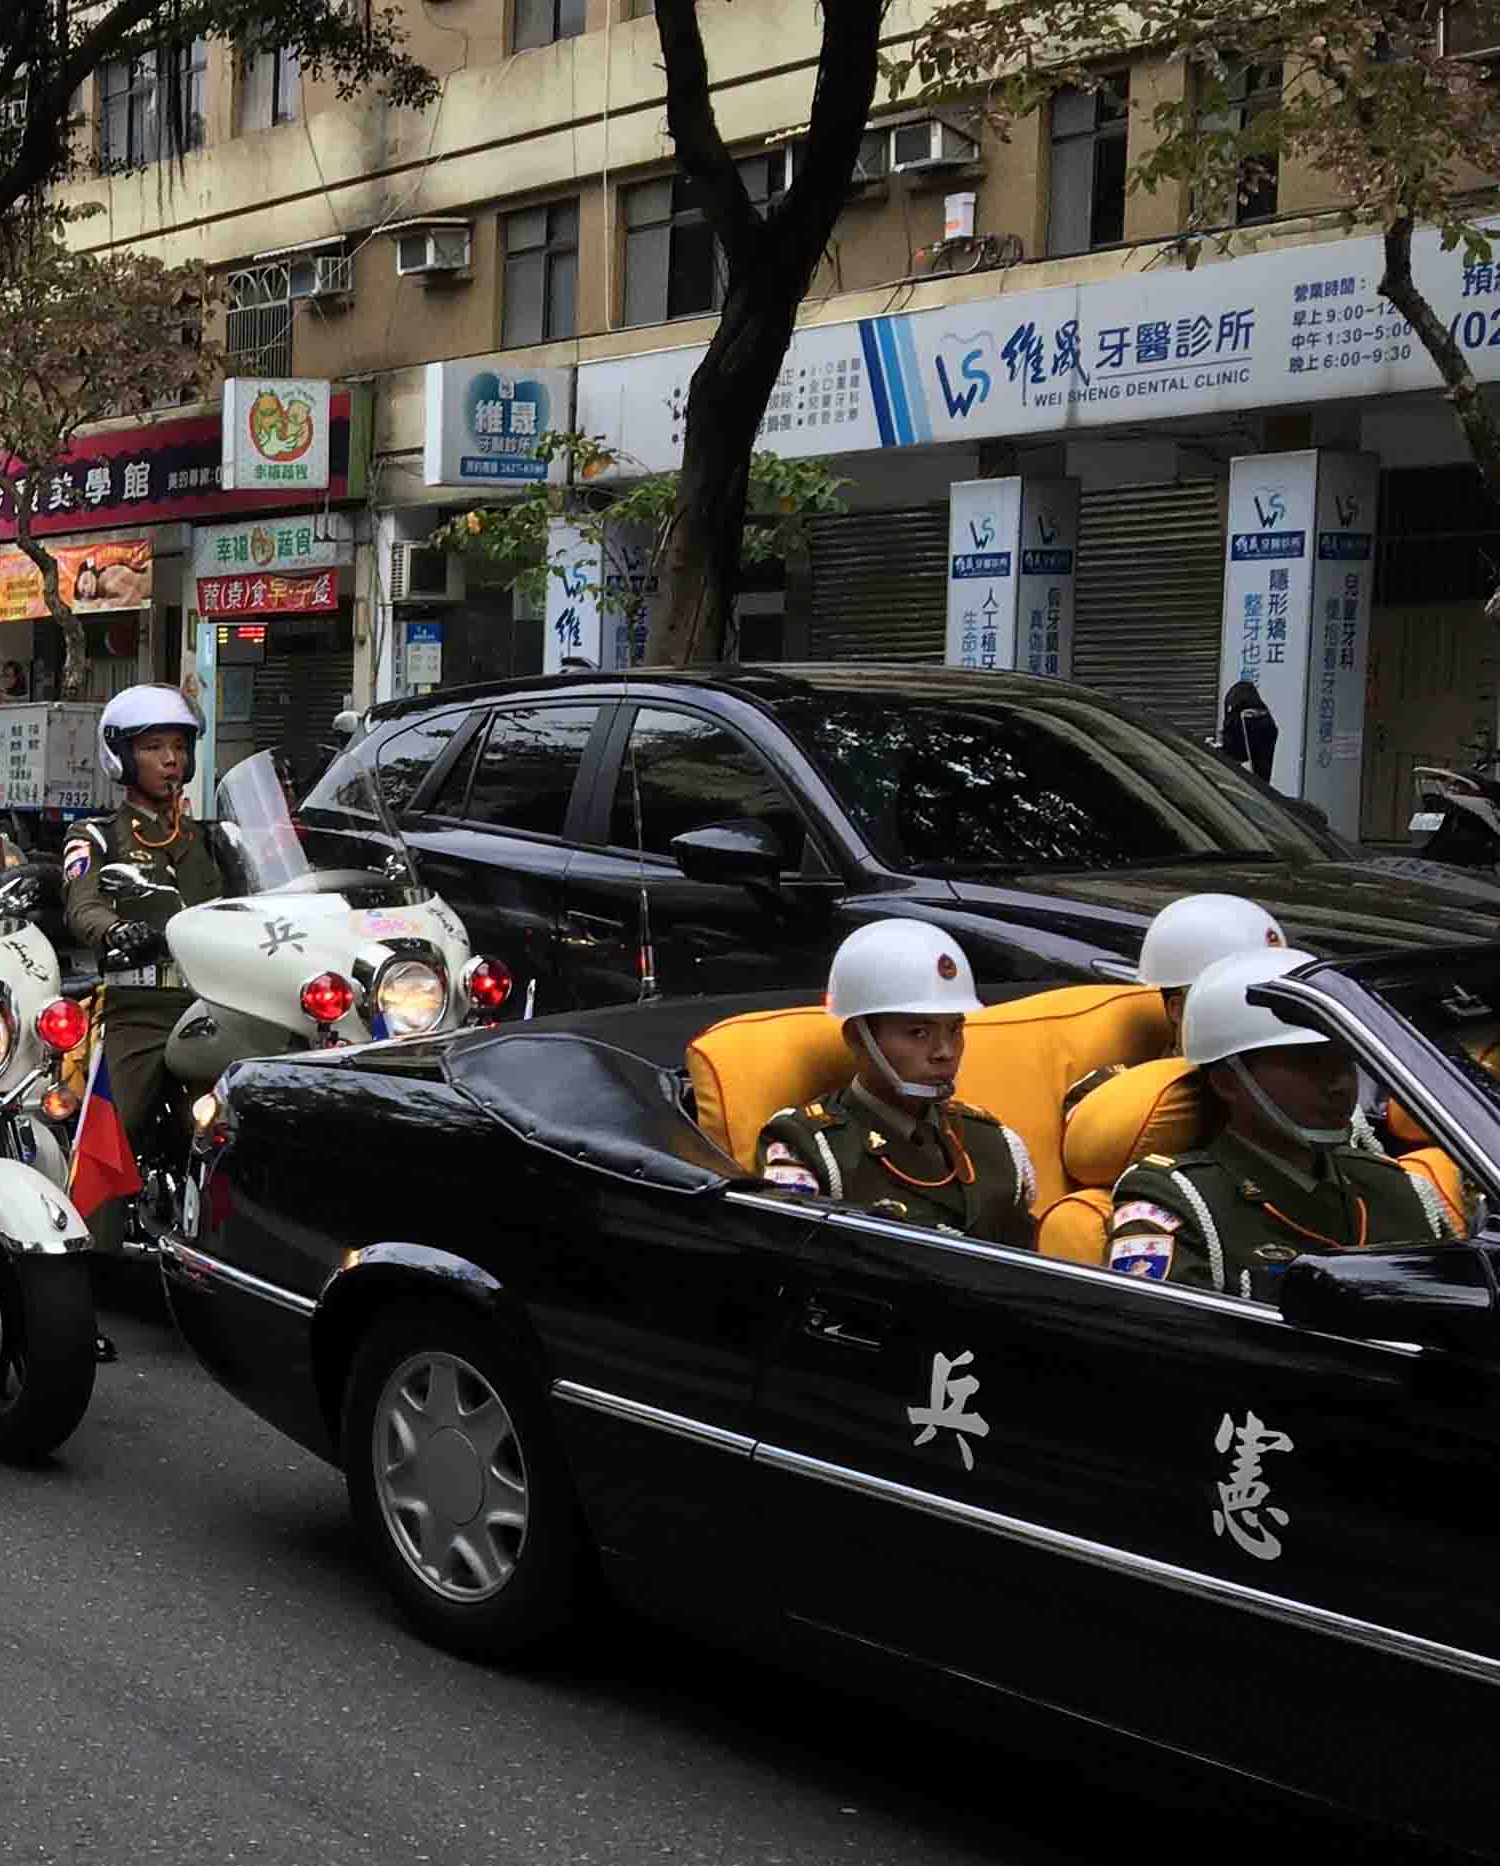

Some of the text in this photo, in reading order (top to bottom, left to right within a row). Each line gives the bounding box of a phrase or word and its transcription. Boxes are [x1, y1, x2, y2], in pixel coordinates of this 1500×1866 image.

[1035, 368, 1250, 408] WEI SHENG DENTAL CLINIC
[58, 791, 89, 808] 7932
[259, 915, 309, 957] 兵
[906, 1350, 1295, 1561] 兵 憲
